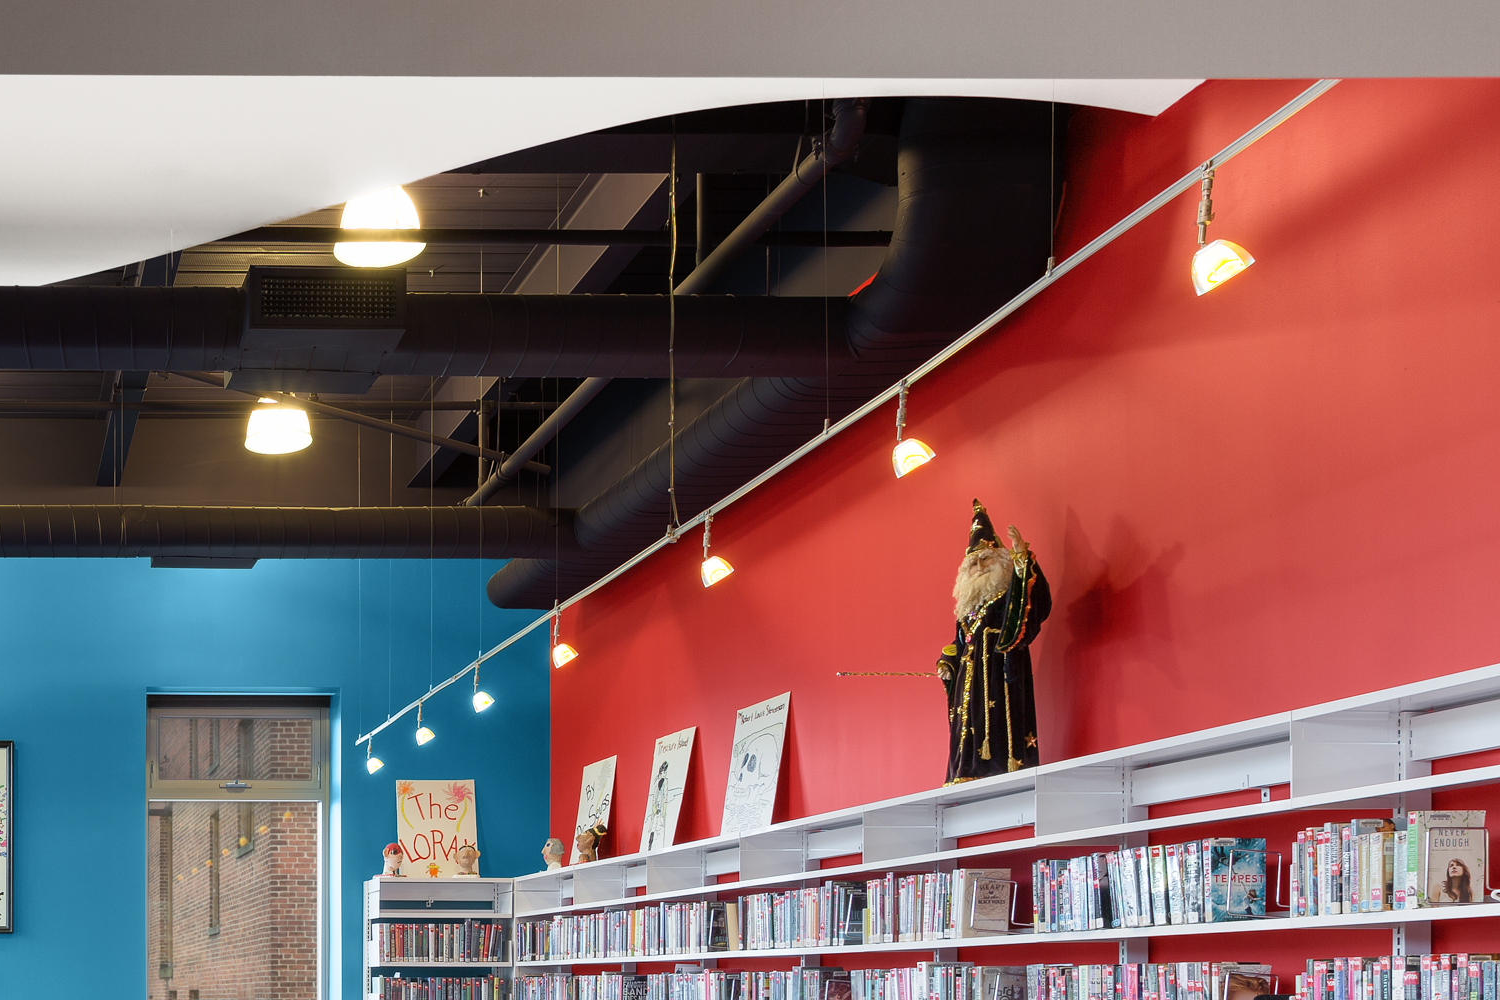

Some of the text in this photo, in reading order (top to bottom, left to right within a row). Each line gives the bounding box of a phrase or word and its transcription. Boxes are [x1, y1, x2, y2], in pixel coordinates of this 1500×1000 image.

[407, 793, 459, 820] The
[399, 829, 476, 864] LORA
[1434, 839, 1469, 847] ENOUGH
[1214, 875, 1264, 883] TEMPEST
